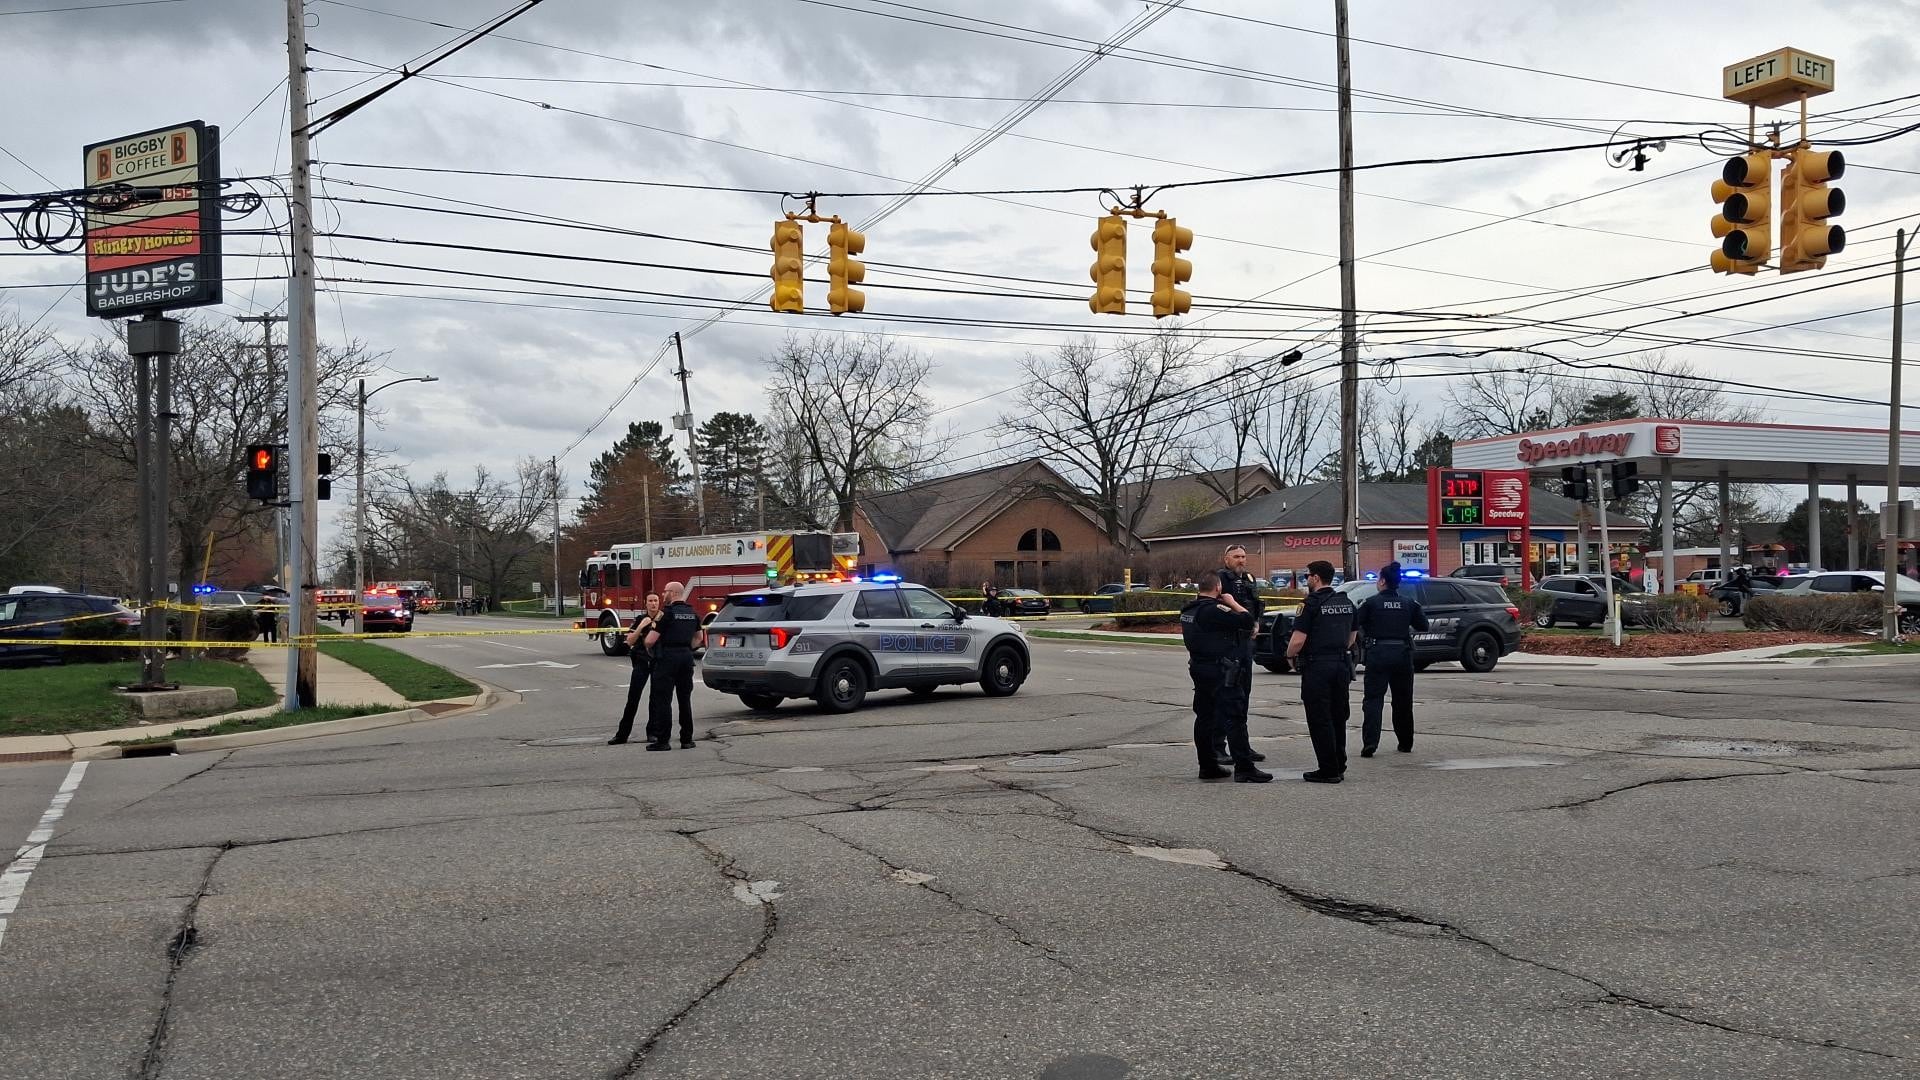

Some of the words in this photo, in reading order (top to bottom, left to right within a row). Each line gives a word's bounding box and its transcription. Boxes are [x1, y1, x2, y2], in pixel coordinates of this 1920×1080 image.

[1734, 59, 1776, 87] LEFT
[1797, 57, 1826, 80] LEFT
[115, 136, 166, 159] BIGGBY
[116, 154, 166, 175] COFFEE
[94, 237, 141, 254] Hungry
[95, 262, 195, 296] JUDE'S
[99, 286, 191, 308] BARBERSHOP
[1517, 432, 1634, 466] Speedway
[1489, 509, 1524, 519] Speedway
[668, 546, 684, 558] EAST
[686, 544, 714, 557] LANSING
[716, 543, 731, 554] FIRE
[1284, 535, 1341, 548] Speedw
[1428, 618, 1460, 633] ICE
[796, 643, 810, 651] 911
[881, 633, 956, 652] POLICE
